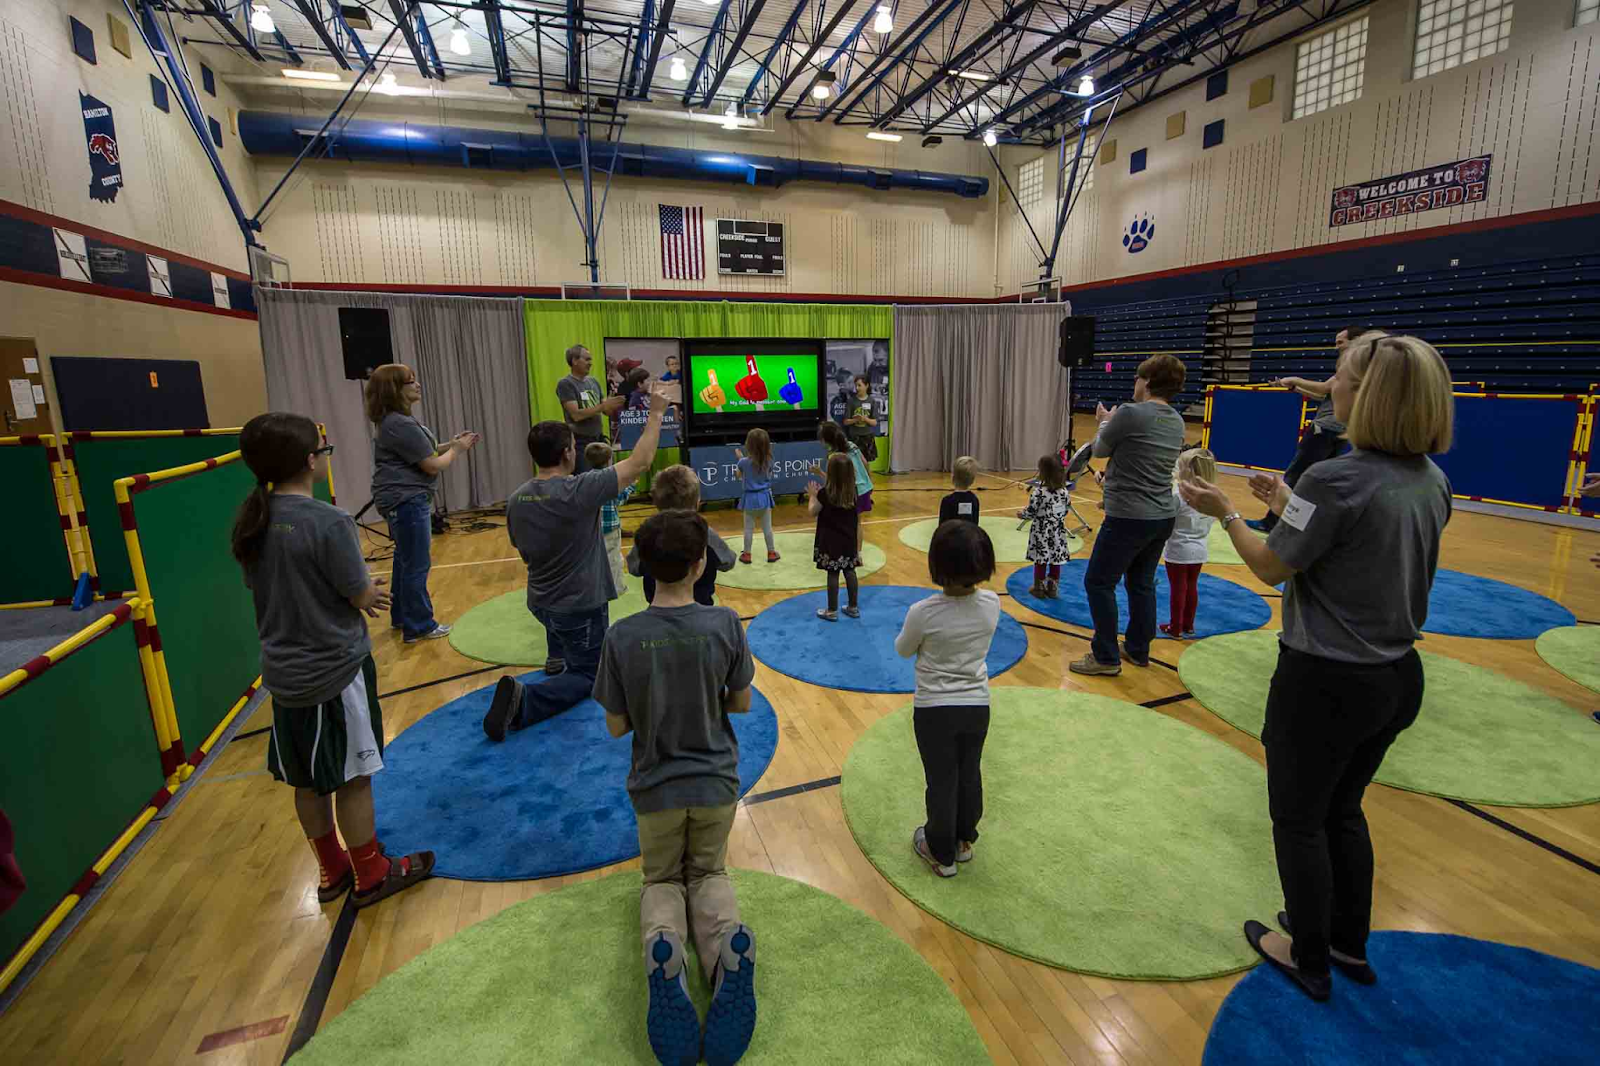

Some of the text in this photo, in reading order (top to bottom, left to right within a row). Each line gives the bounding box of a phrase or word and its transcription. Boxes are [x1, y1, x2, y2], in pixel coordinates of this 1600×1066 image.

[1359, 170, 1453, 200] WELCOME TO
[1331, 180, 1486, 227] CREEKSIDE
[747, 359, 757, 376] 1
[788, 371, 796, 384] 1
